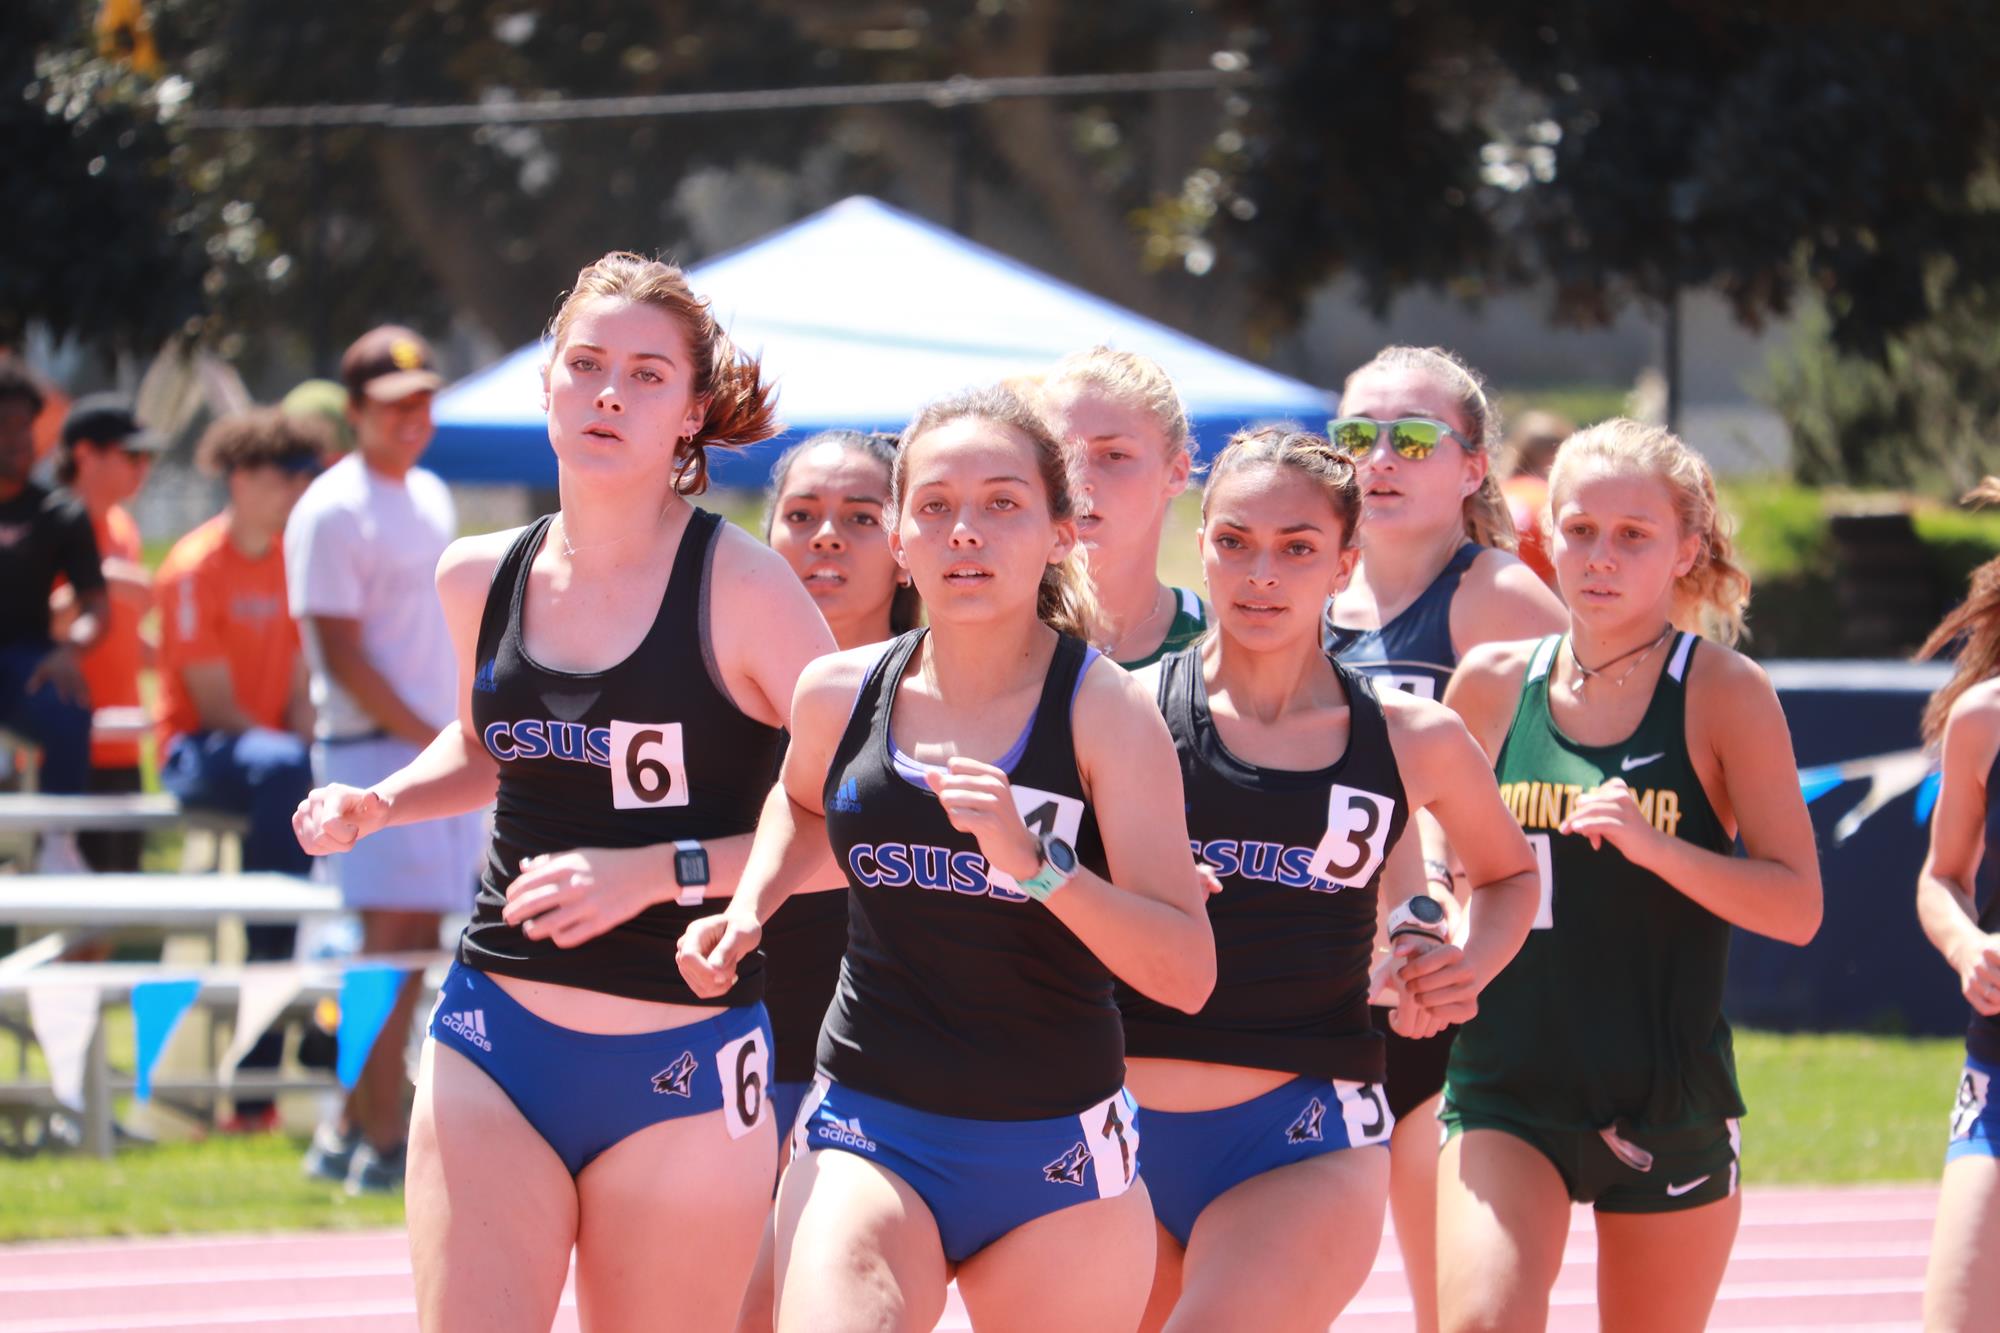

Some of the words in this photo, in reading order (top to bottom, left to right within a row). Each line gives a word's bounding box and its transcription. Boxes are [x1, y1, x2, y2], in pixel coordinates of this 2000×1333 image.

[625, 730, 671, 803] 6
[1189, 840, 1347, 893] SUS
[1325, 796, 1380, 880] 3
[849, 842, 1031, 903] CSUS
[441, 1014, 493, 1052] adidas
[735, 1039, 761, 1128] 6
[818, 1126, 877, 1152] adidas
